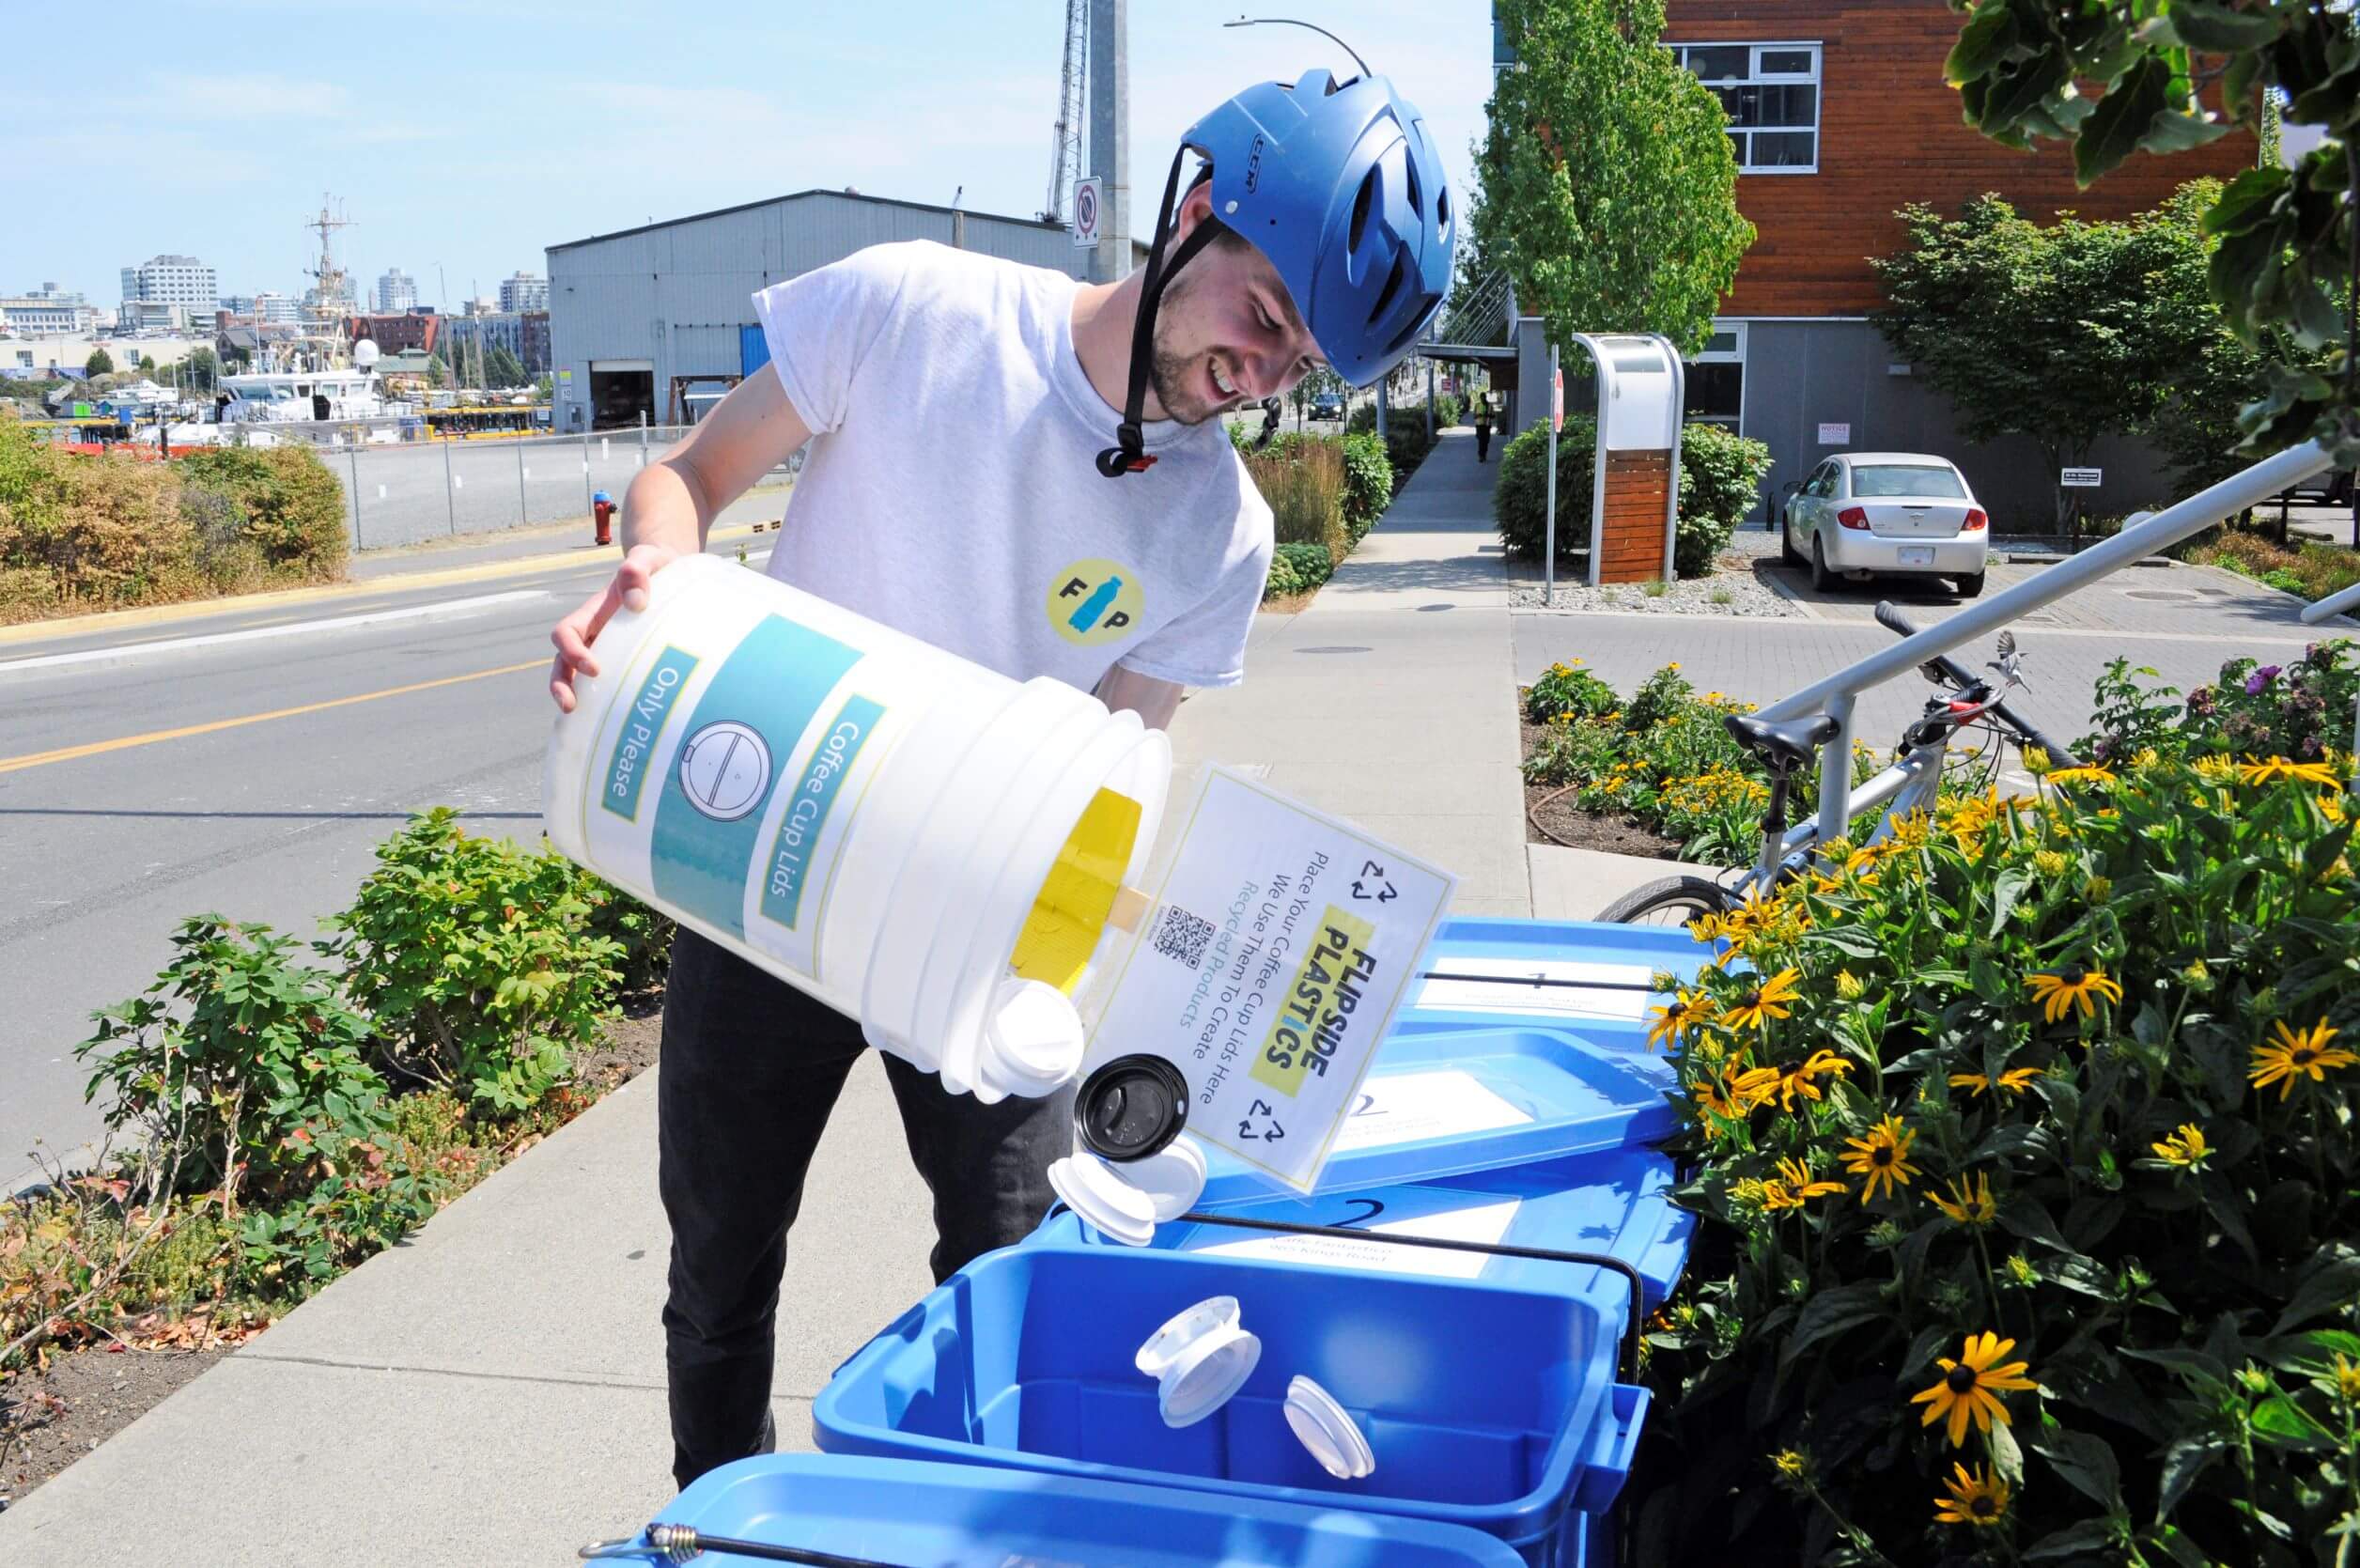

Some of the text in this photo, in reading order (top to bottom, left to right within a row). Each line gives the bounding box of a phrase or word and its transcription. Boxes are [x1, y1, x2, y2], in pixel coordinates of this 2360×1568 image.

[1246, 139, 1264, 186] CCM
[1059, 577, 1088, 598] F
[1103, 610, 1129, 629] P
[613, 667, 679, 798] Only Please
[770, 721, 860, 898] Coffee Cup Lids
[1180, 880, 1260, 1029] Recycled Products
[1193, 874, 1292, 1060] We Use Them To Create
[1200, 850, 1329, 1105] Place Your Coffee Cup Lids Here
[1265, 924, 1350, 1070] PLASTICS
[1299, 948, 1377, 1078] FLIPSIDE
[1350, 1094, 1389, 1117] 2
[1325, 1198, 1385, 1232] 2
